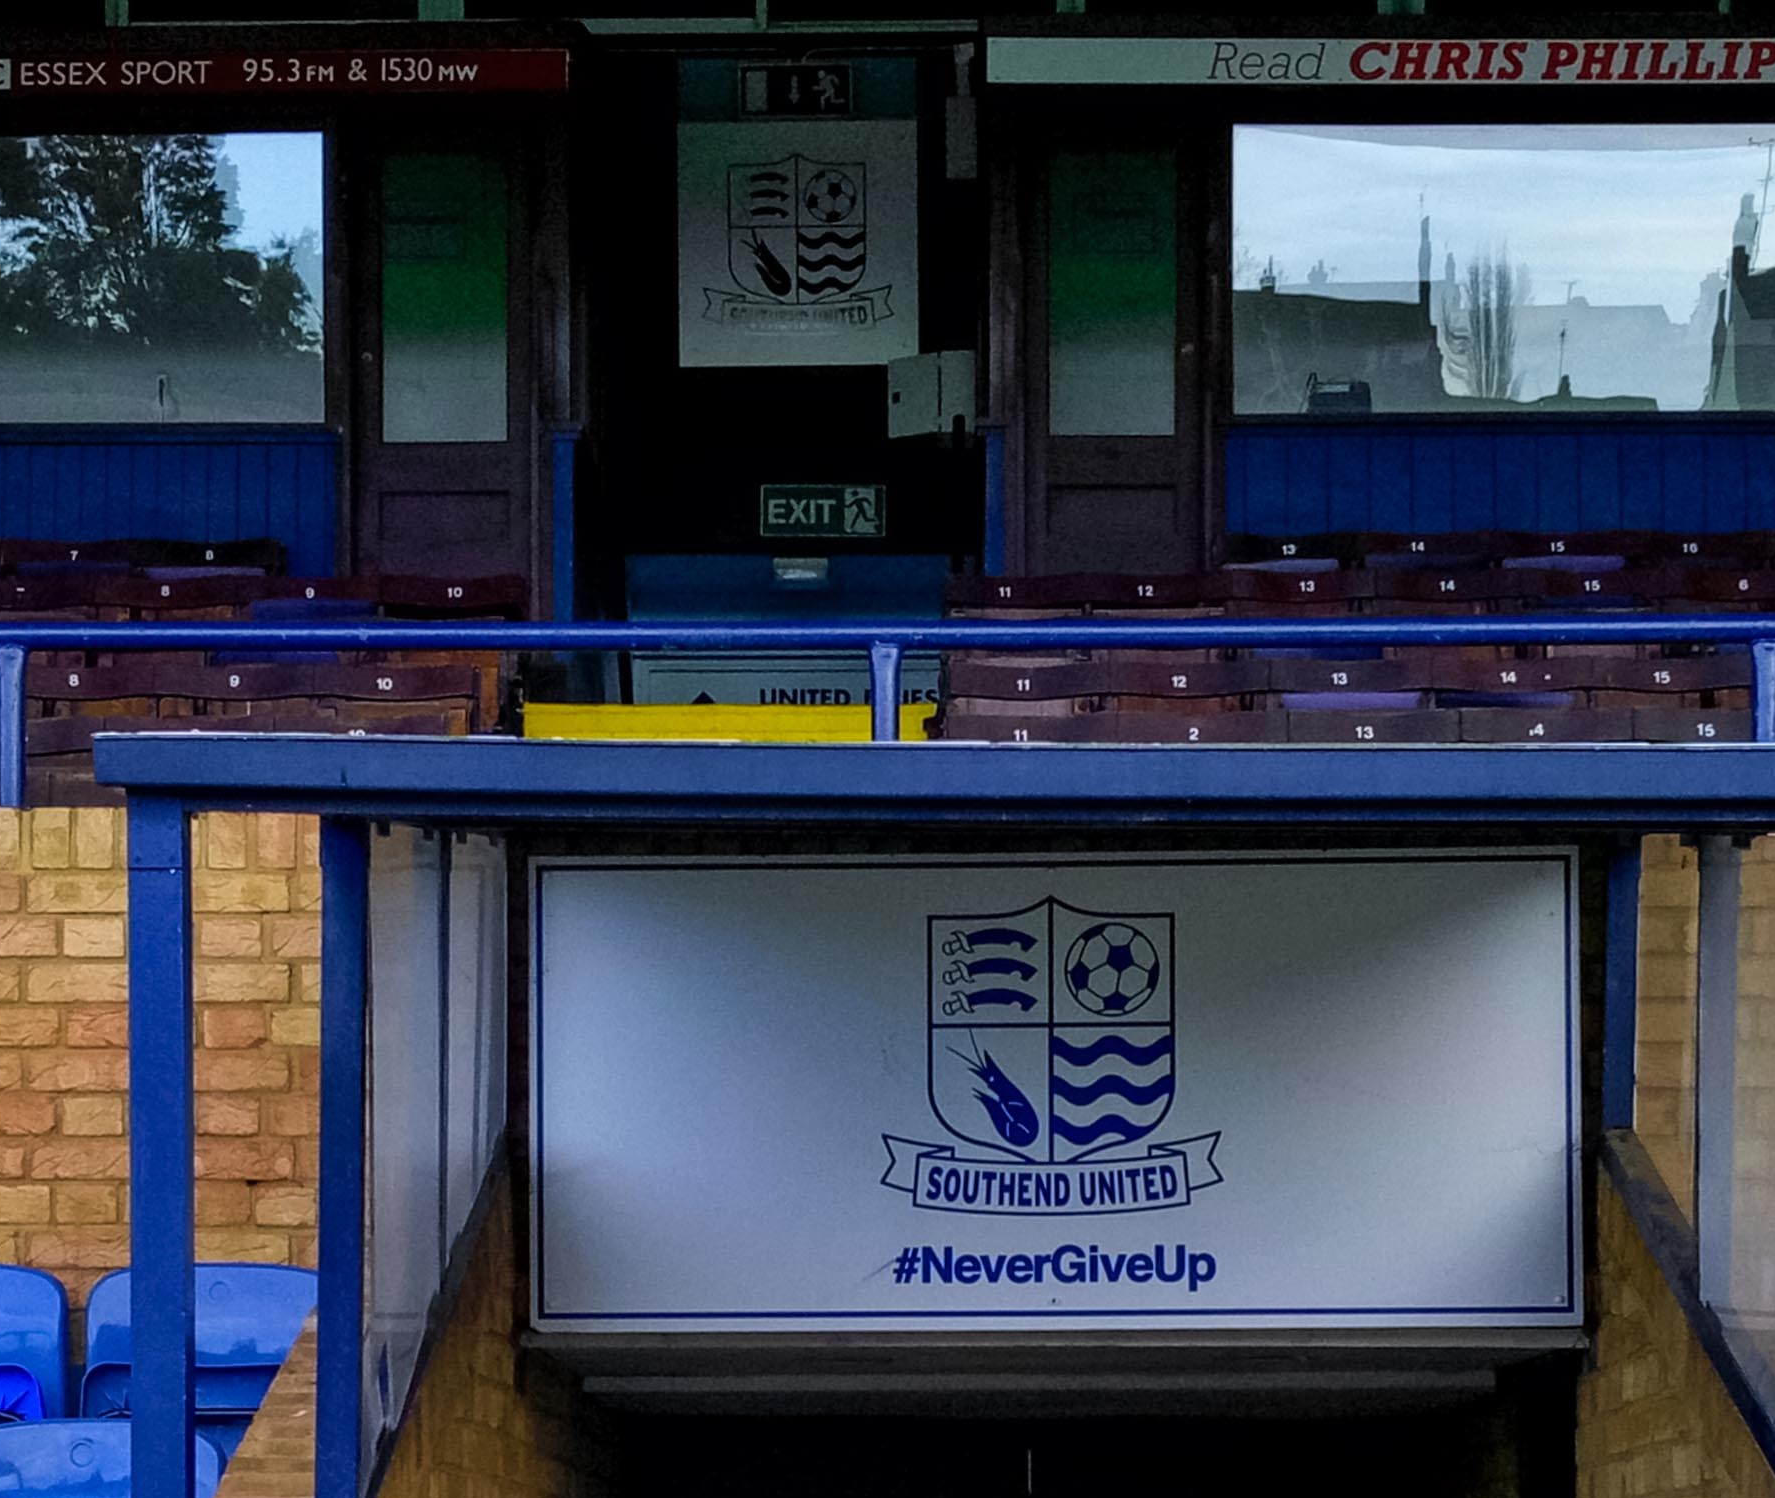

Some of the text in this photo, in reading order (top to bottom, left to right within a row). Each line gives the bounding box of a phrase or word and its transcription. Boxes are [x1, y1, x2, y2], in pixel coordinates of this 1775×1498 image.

[1207, 41, 1326, 81] Read
[1349, 41, 1528, 81] CHRIS
[20, 62, 106, 87] ESSEX
[120, 60, 213, 87] SPORT
[348, 58, 367, 83] &
[768, 499, 837, 524] EXIT
[376, 677, 393, 691] 10
[1171, 675, 1187, 688] 12
[1331, 672, 1348, 685] 13
[1500, 671, 1517, 684] 14
[1653, 670, 1671, 684] 15
[1016, 678, 1030, 692] 11
[759, 688, 851, 705] UNITED
[1013, 728, 1029, 742] 11
[1355, 726, 1375, 740] 13
[925, 1164, 1179, 1208] SOUTHEND UNITED
[892, 1244, 1218, 1293] #NeverGiveUp
